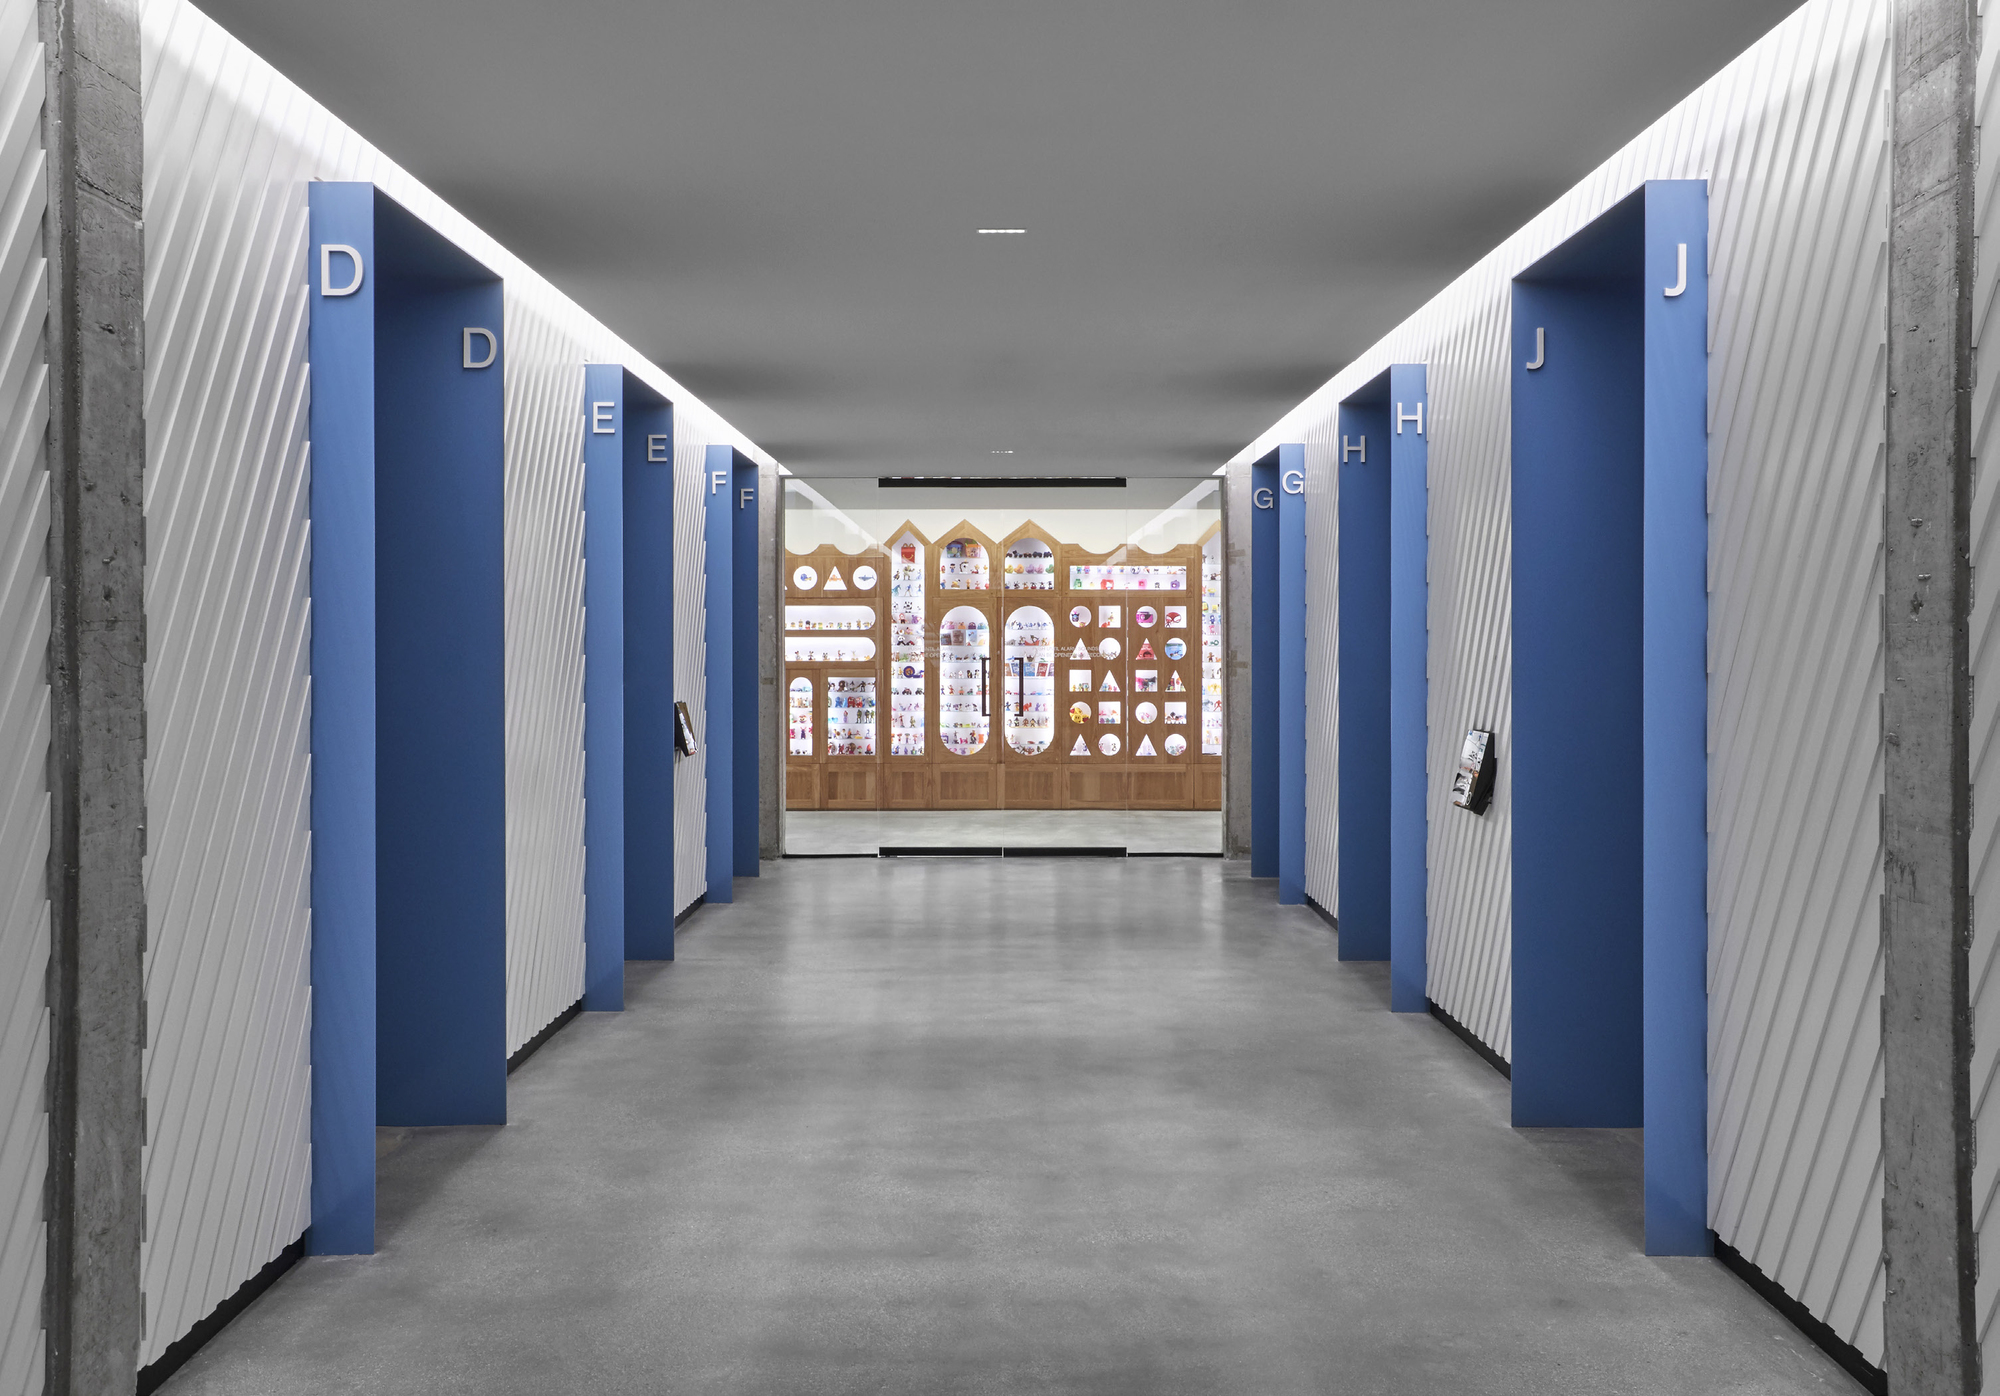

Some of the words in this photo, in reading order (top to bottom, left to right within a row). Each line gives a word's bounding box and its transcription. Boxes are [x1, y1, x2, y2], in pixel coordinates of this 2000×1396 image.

[320, 244, 364, 296] D
[1665, 243, 1687, 297] J
[463, 328, 498, 368] D
[1526, 328, 1545, 370] J
[593, 402, 616, 434] E
[1397, 402, 1423, 434] H
[647, 434, 668, 462] E
[1343, 435, 1366, 463] H
[712, 471, 727, 494] F
[1282, 470, 1304, 494] G
[740, 489, 755, 508] F
[1254, 487, 1274, 509] G
